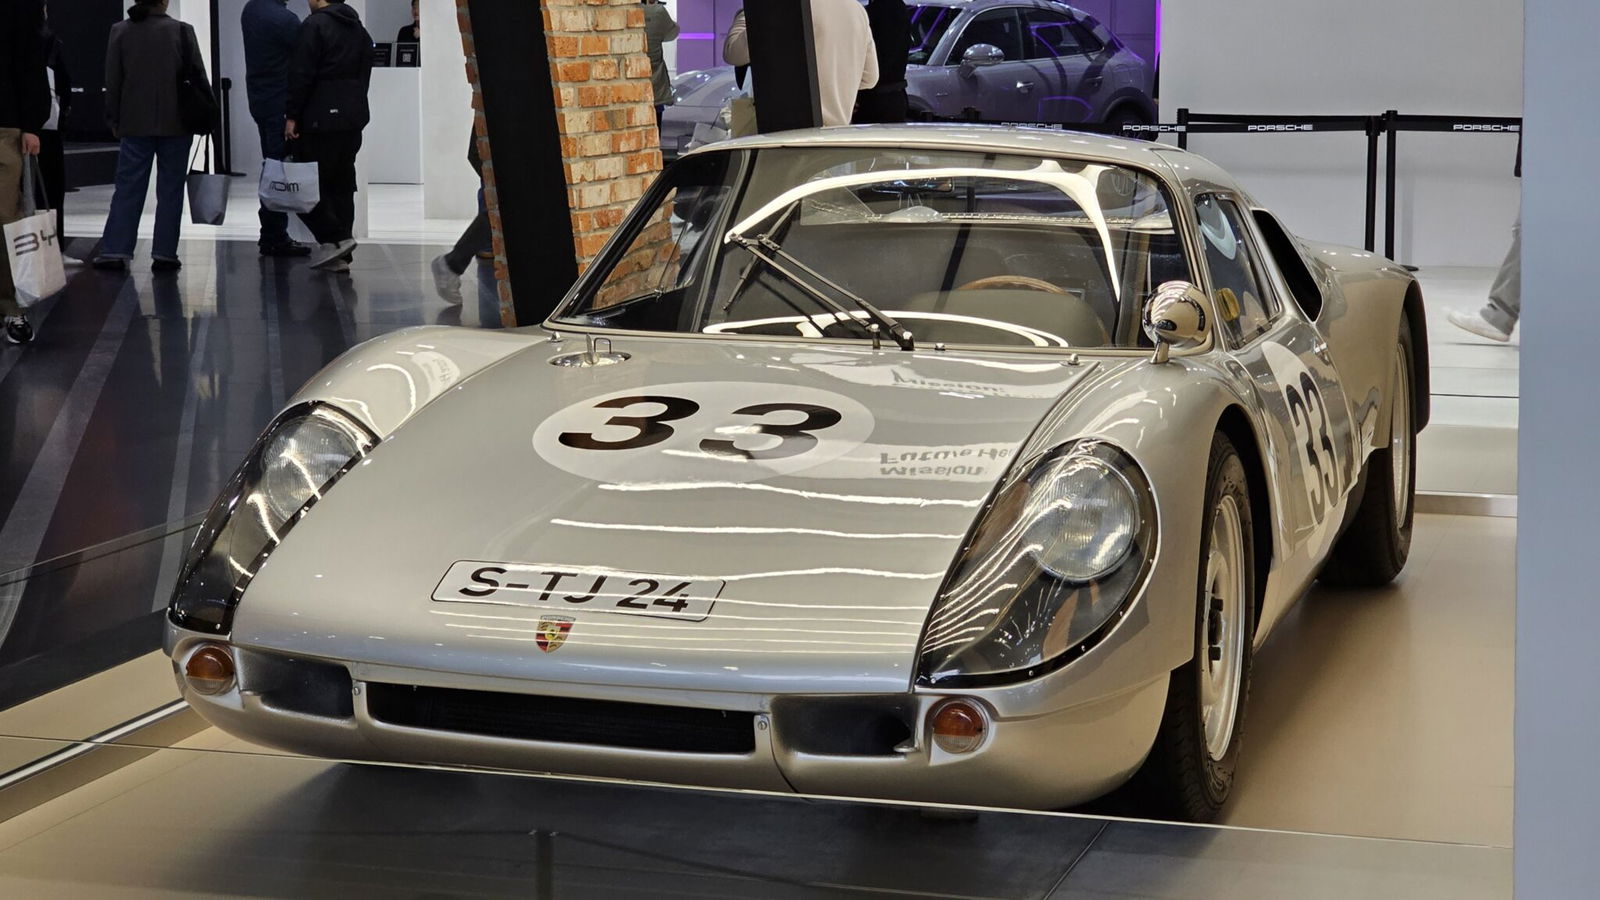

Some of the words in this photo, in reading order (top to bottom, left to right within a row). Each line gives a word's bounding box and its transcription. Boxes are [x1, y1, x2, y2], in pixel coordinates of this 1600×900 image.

[558, 395, 842, 460] 33
[1285, 371, 1340, 525] 33
[458, 567, 608, 604] S-TJ
[616, 578, 692, 613] 24
